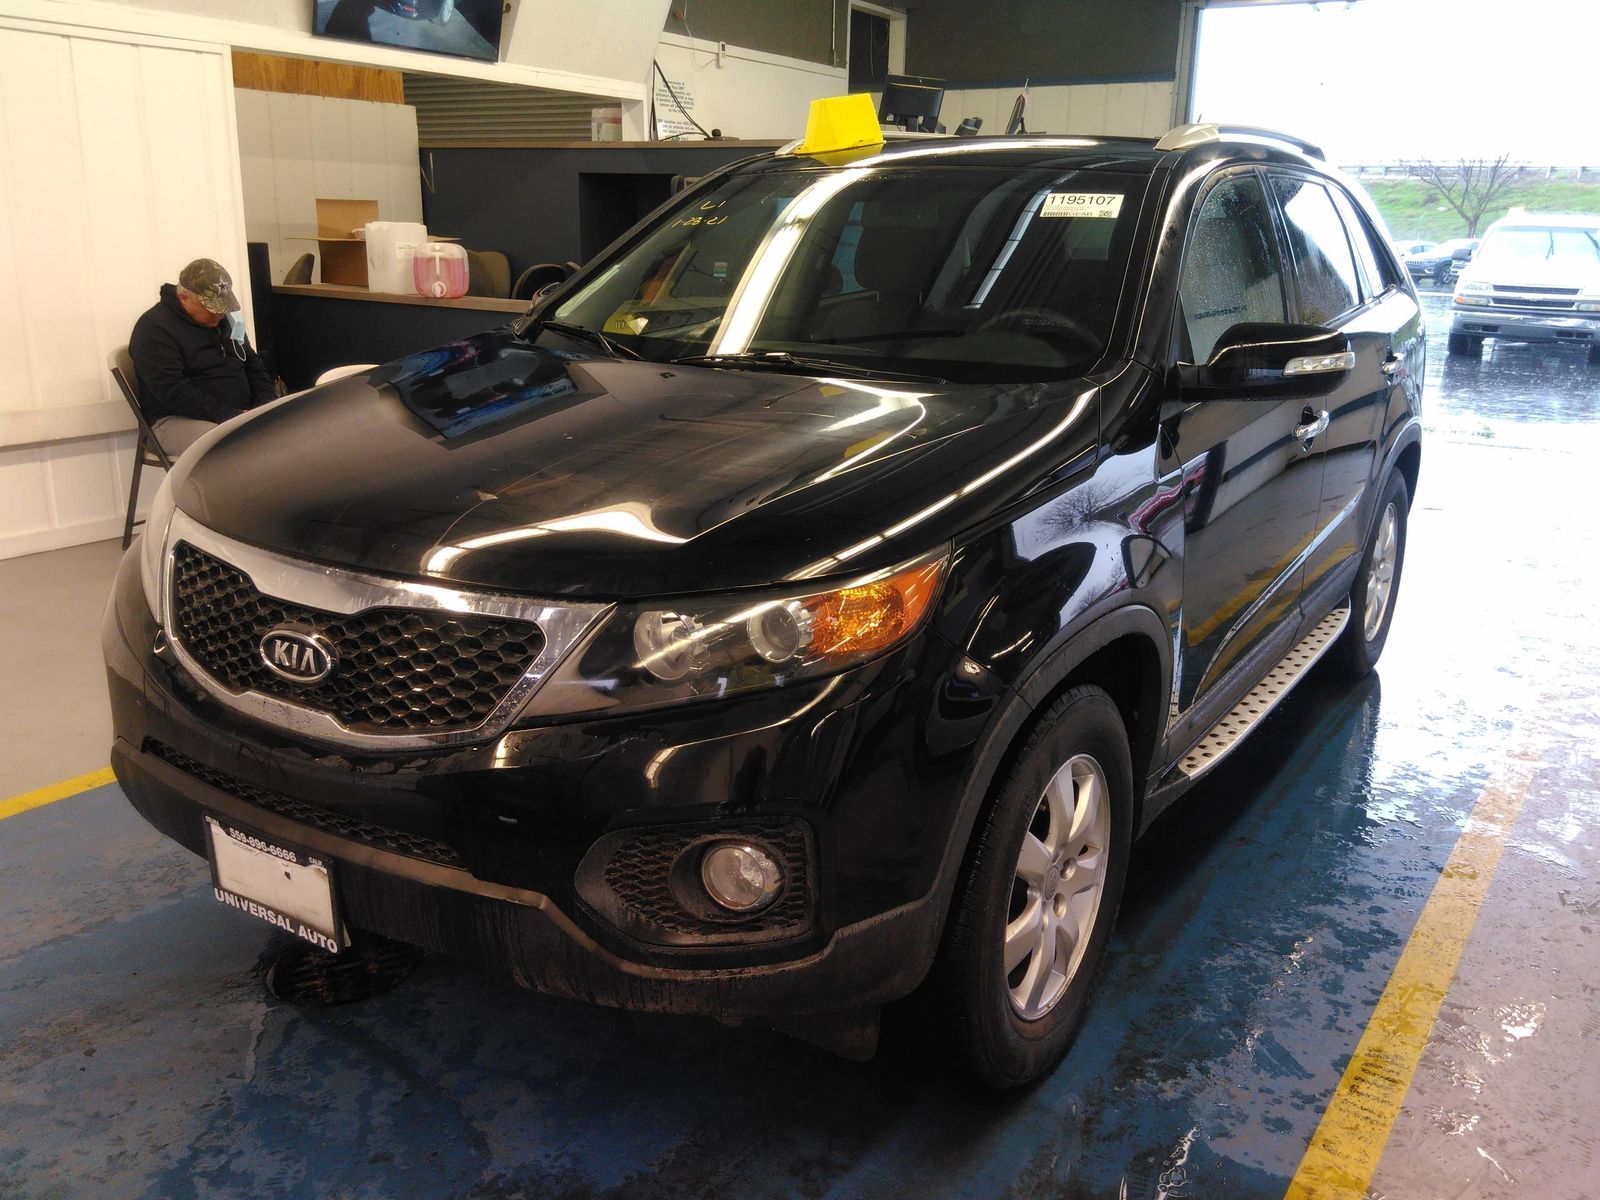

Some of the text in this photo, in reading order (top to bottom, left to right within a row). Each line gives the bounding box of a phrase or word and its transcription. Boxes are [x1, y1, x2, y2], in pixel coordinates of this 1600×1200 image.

[1050, 195, 1116, 205] 1195107
[274, 639, 316, 674] KIA
[229, 827, 297, 863] 559-896-6666
[214, 887, 338, 954] UNIVERSAL AUTO
